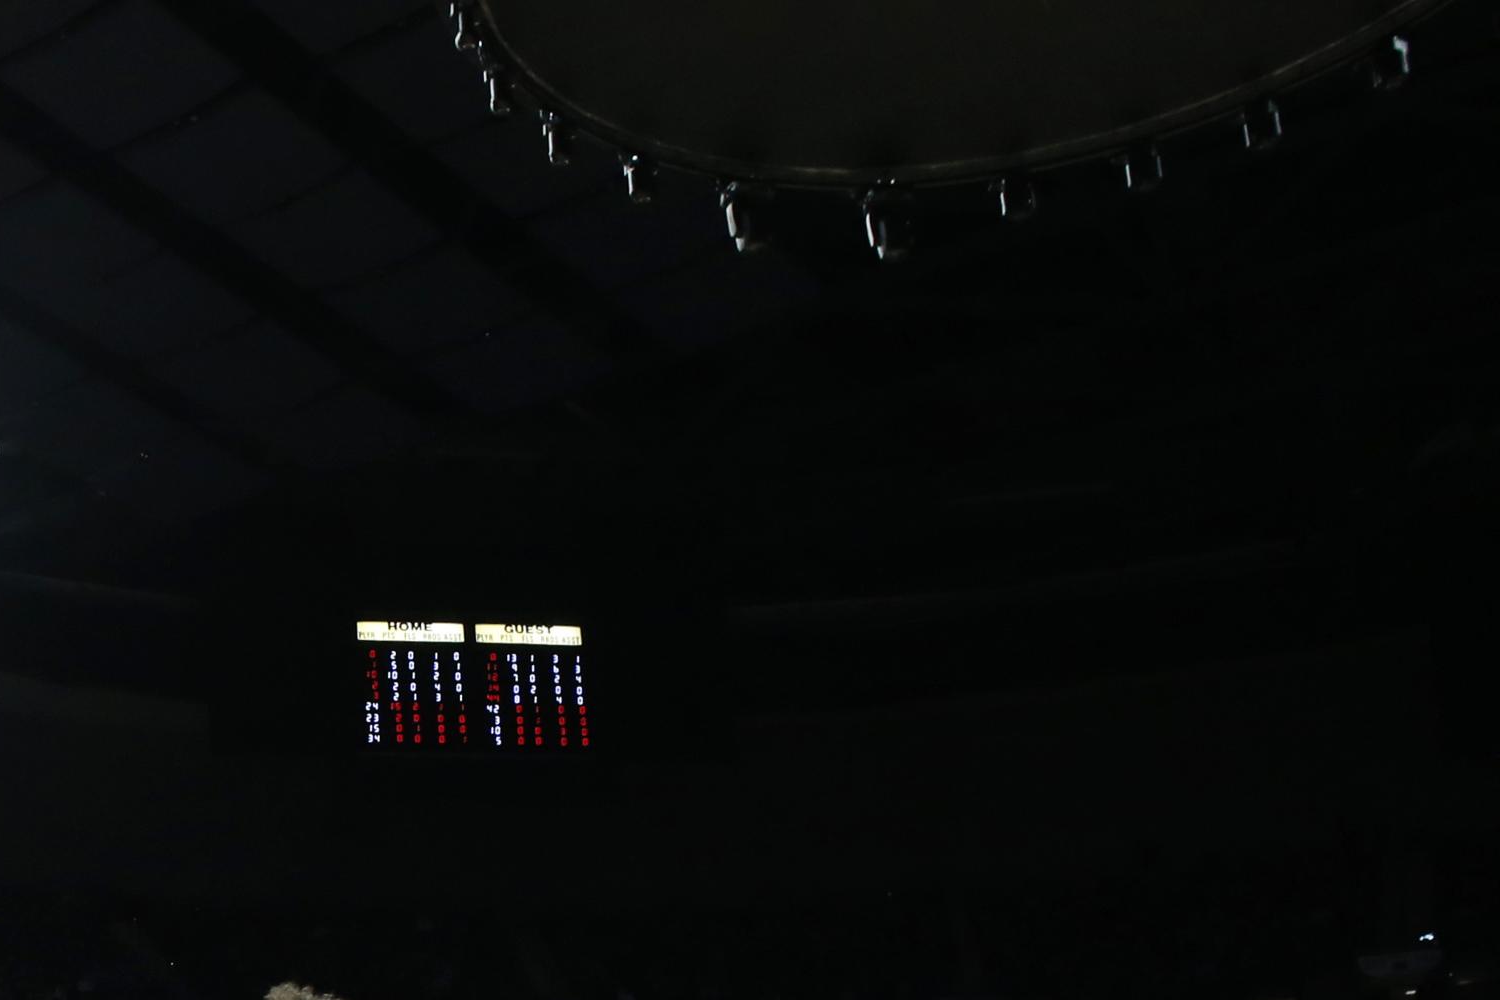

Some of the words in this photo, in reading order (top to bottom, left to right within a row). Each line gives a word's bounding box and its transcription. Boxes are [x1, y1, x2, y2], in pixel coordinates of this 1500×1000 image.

[388, 622, 432, 631] HOME
[505, 624, 553, 633] GUEST
[390, 651, 396, 659] 2
[408, 651, 414, 660] 0
[453, 652, 459, 661] 0
[507, 653, 517, 662] 13
[531, 654, 534, 662] 1
[553, 654, 558, 663] 3
[391, 661, 397, 670] 5
[409, 661, 414, 670] 0
[433, 661, 439, 670] 3
[532, 664, 535, 672] 1
[575, 665, 581, 674] 3
[388, 671, 398, 680] 10
[433, 672, 439, 681] 2
[455, 672, 461, 681] 0
[513, 674, 518, 682] 7
[530, 674, 535, 683] 0
[554, 675, 560, 683] 2
[576, 675, 582, 683] 4
[393, 682, 399, 691] 2
[410, 682, 416, 691] 0
[435, 683, 440, 691] 4
[456, 683, 462, 692] 0
[513, 685, 519, 694] 0
[530, 685, 536, 694] 2
[555, 686, 561, 694] 0
[576, 686, 582, 695] 0
[393, 692, 399, 701] 2
[414, 693, 417, 701] 1
[436, 693, 441, 702] 3
[459, 694, 462, 702] 1
[556, 696, 562, 704] 4
[577, 696, 583, 705] 0
[366, 702, 379, 711] 24
[486, 704, 499, 713] 42
[366, 713, 379, 722] 23
[495, 716, 500, 725] 3
[369, 724, 379, 733] 15
[490, 726, 501, 735] 10
[368, 734, 380, 743] 34
[495, 737, 501, 745] 5
